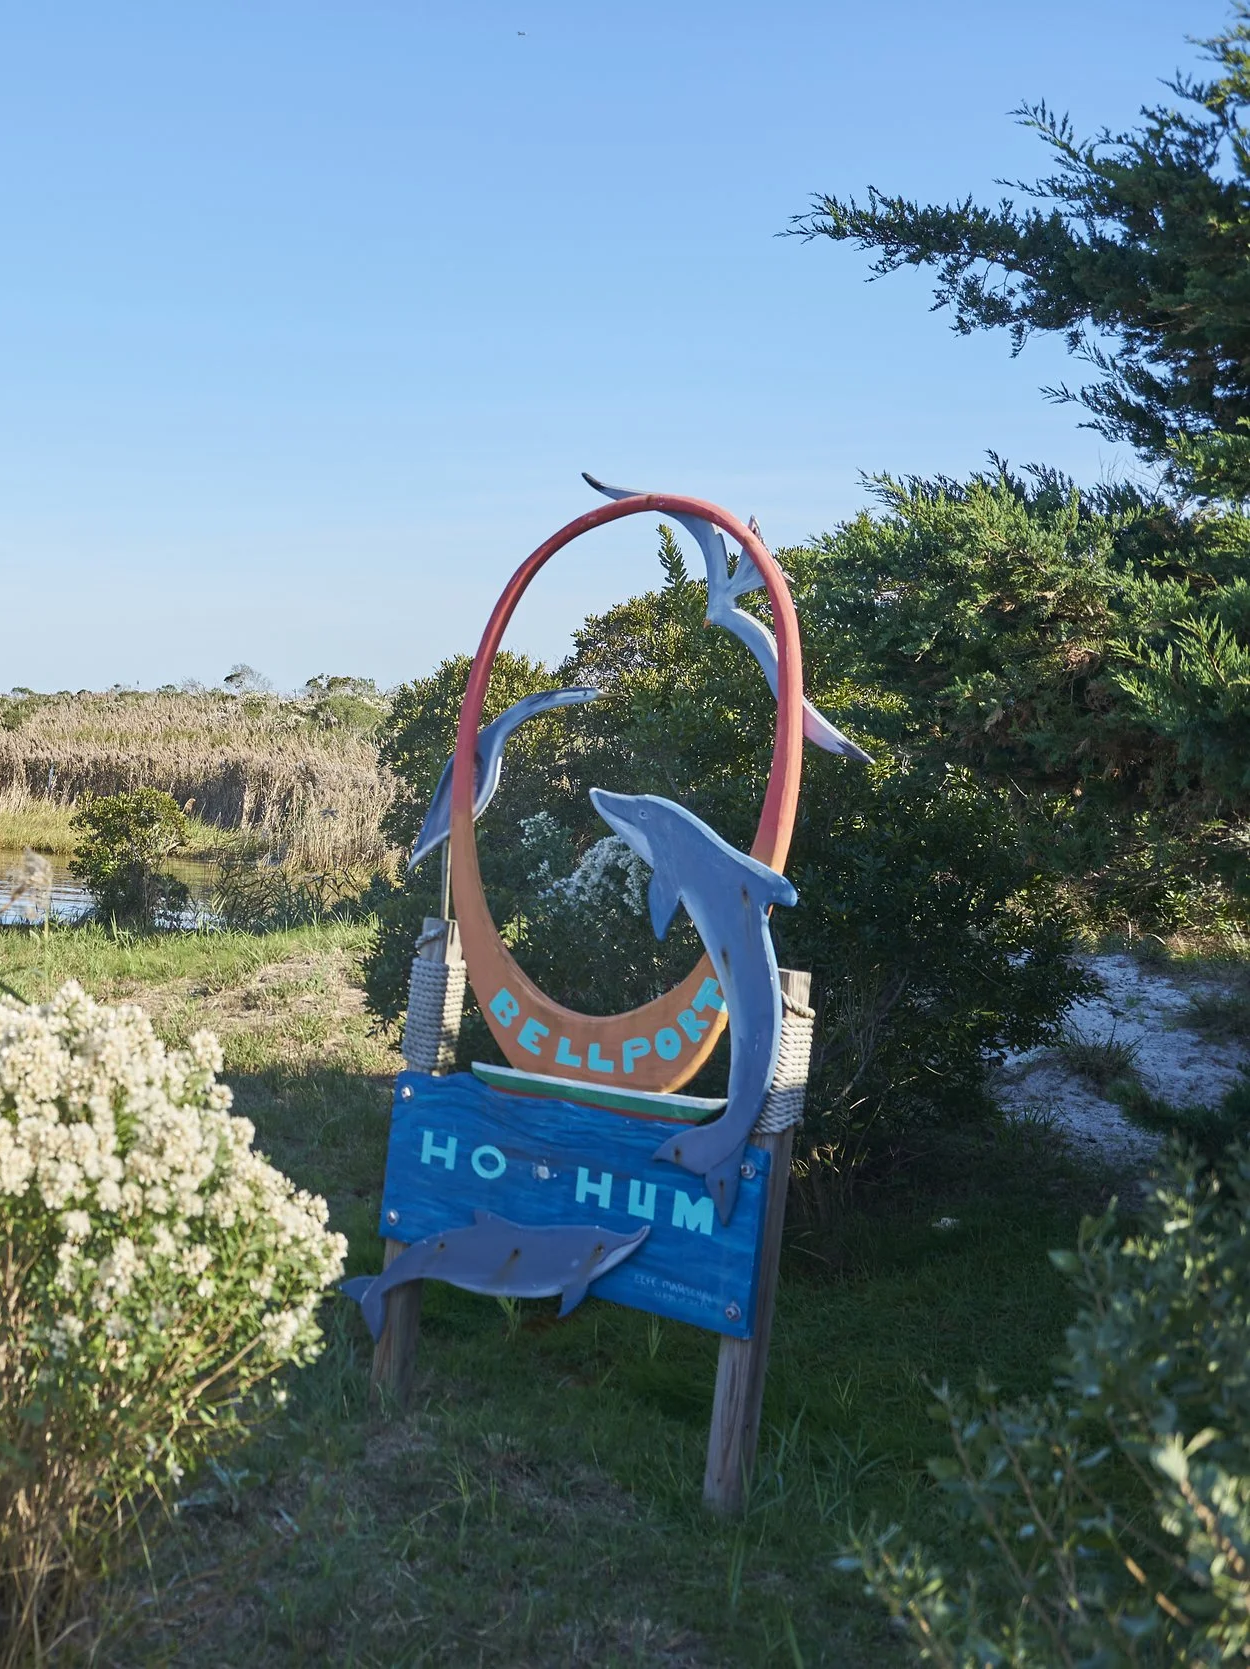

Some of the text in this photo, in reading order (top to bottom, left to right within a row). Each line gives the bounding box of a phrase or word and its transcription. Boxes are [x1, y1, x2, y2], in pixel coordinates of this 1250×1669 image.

[489, 976, 728, 1074] BELLPORT
[420, 1129, 714, 1236] HO HUM
